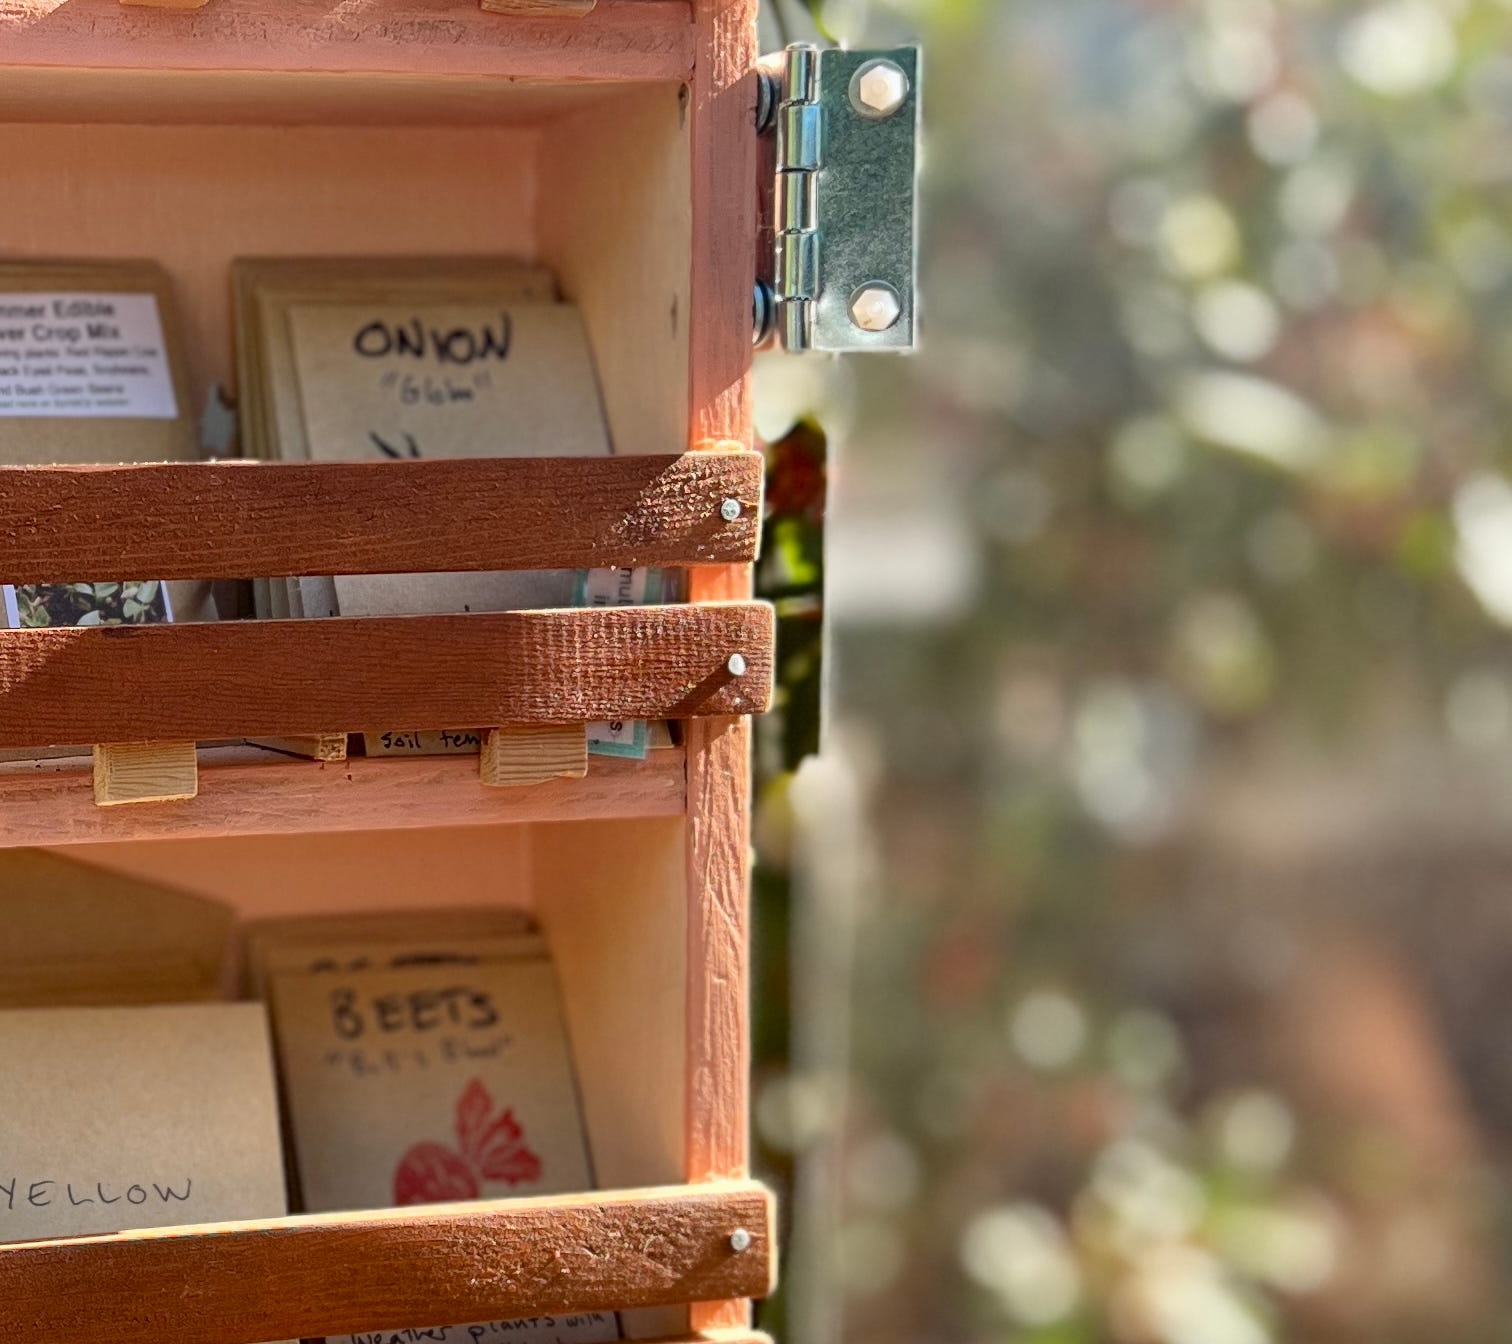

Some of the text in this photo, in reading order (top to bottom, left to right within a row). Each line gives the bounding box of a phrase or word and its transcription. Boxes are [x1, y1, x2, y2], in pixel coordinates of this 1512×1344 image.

[31, 323, 82, 343] Crop
[85, 323, 121, 341] Mix
[354, 310, 513, 365] ONION
[330, 985, 501, 1040] BEETS
